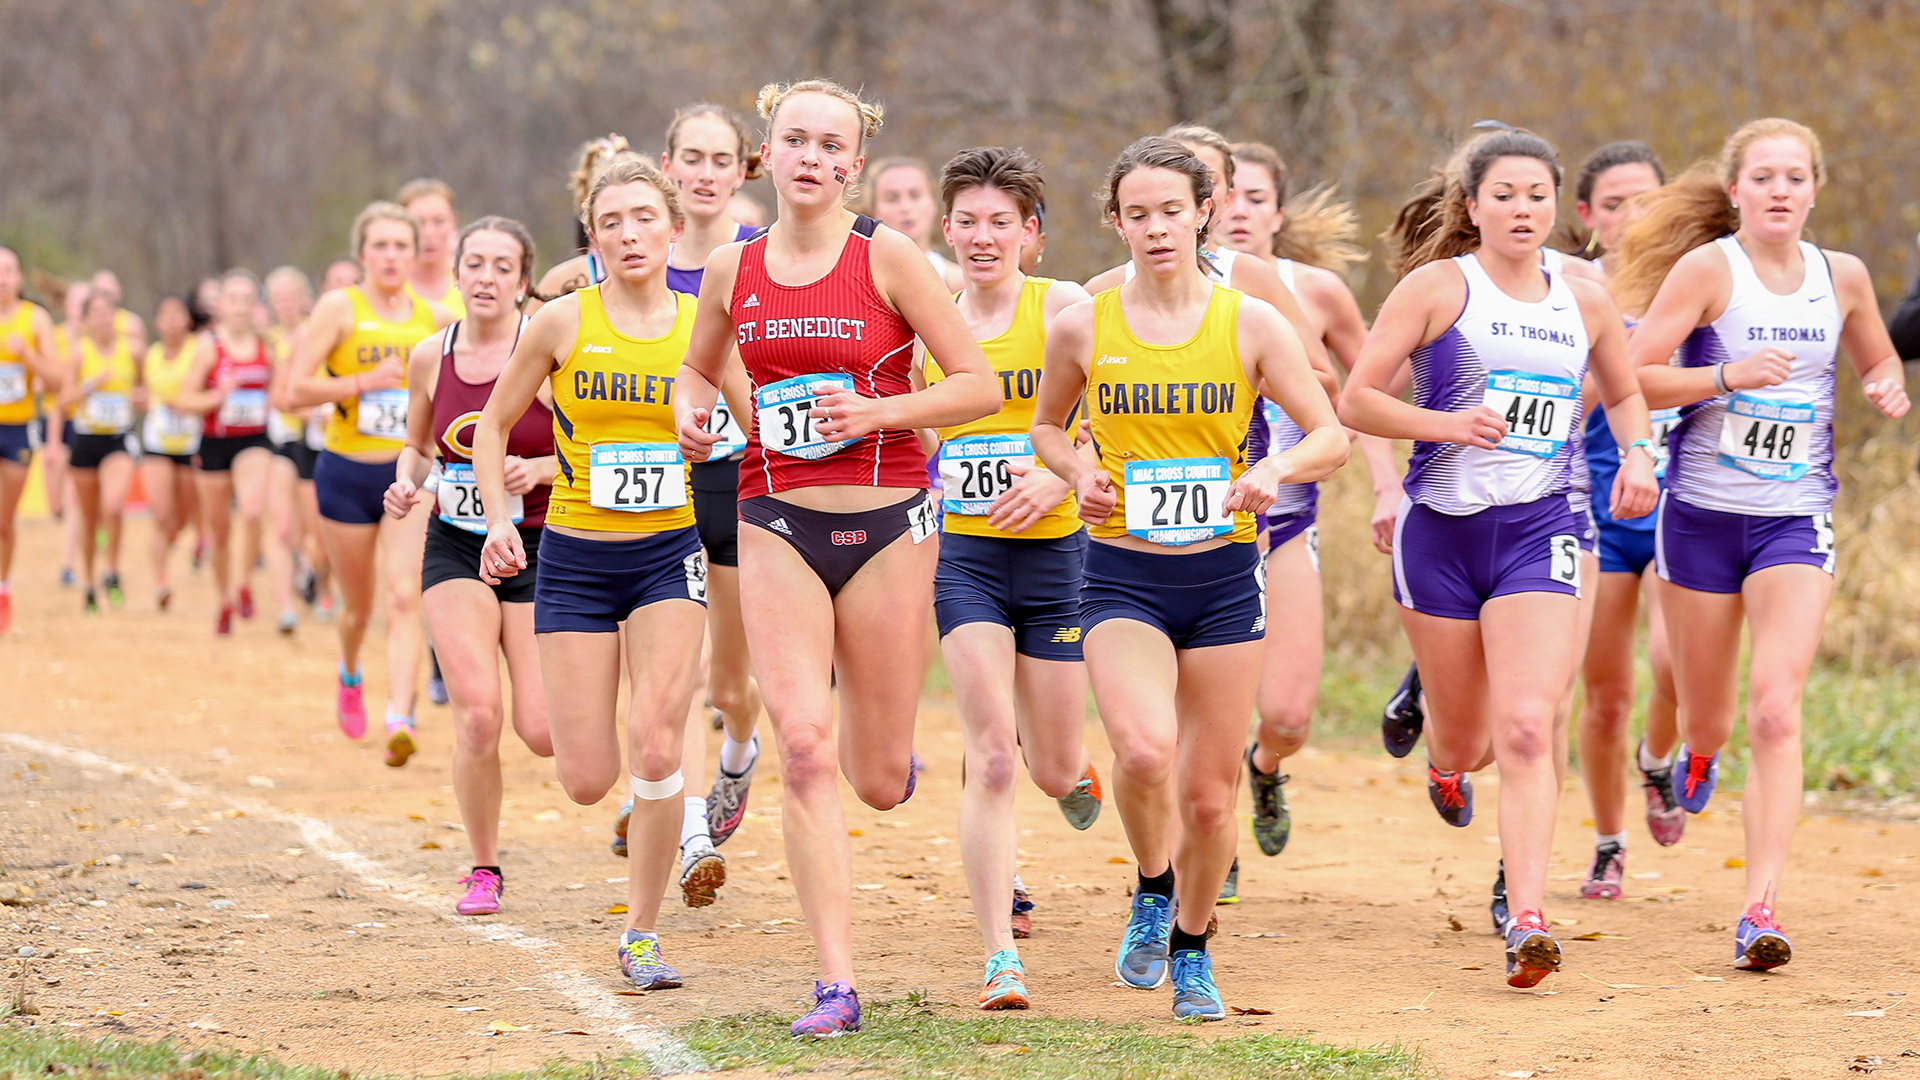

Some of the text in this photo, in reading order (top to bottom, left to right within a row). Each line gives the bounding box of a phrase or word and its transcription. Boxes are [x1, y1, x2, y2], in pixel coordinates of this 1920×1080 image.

[738, 316, 866, 345] ST. BENEDICT
[1490, 321, 1576, 348] ST. THOMAS
[1747, 326, 1826, 342] ST. THOMAS
[574, 369, 676, 405] CARLET
[780, 383, 806, 401] CROSS
[1098, 382, 1236, 415] CARLETON
[1515, 378, 1541, 394] CROSS
[778, 398, 823, 446] 37
[1505, 395, 1555, 436] 440
[964, 442, 989, 456] CROSS
[989, 440, 1026, 455] COUNTRY
[1743, 421, 1796, 460] 448
[618, 450, 645, 464] CROSS
[645, 450, 678, 463] COUNTRY
[614, 467, 665, 504] 257
[960, 459, 1012, 498] 269
[1132, 465, 1222, 482] MIAC CROSS COUNTRY
[550, 506, 567, 514] 113
[1150, 483, 1209, 526] 270
[831, 530, 868, 546] CSB
[1147, 528, 1215, 543] CHAMPIONSHIPS
